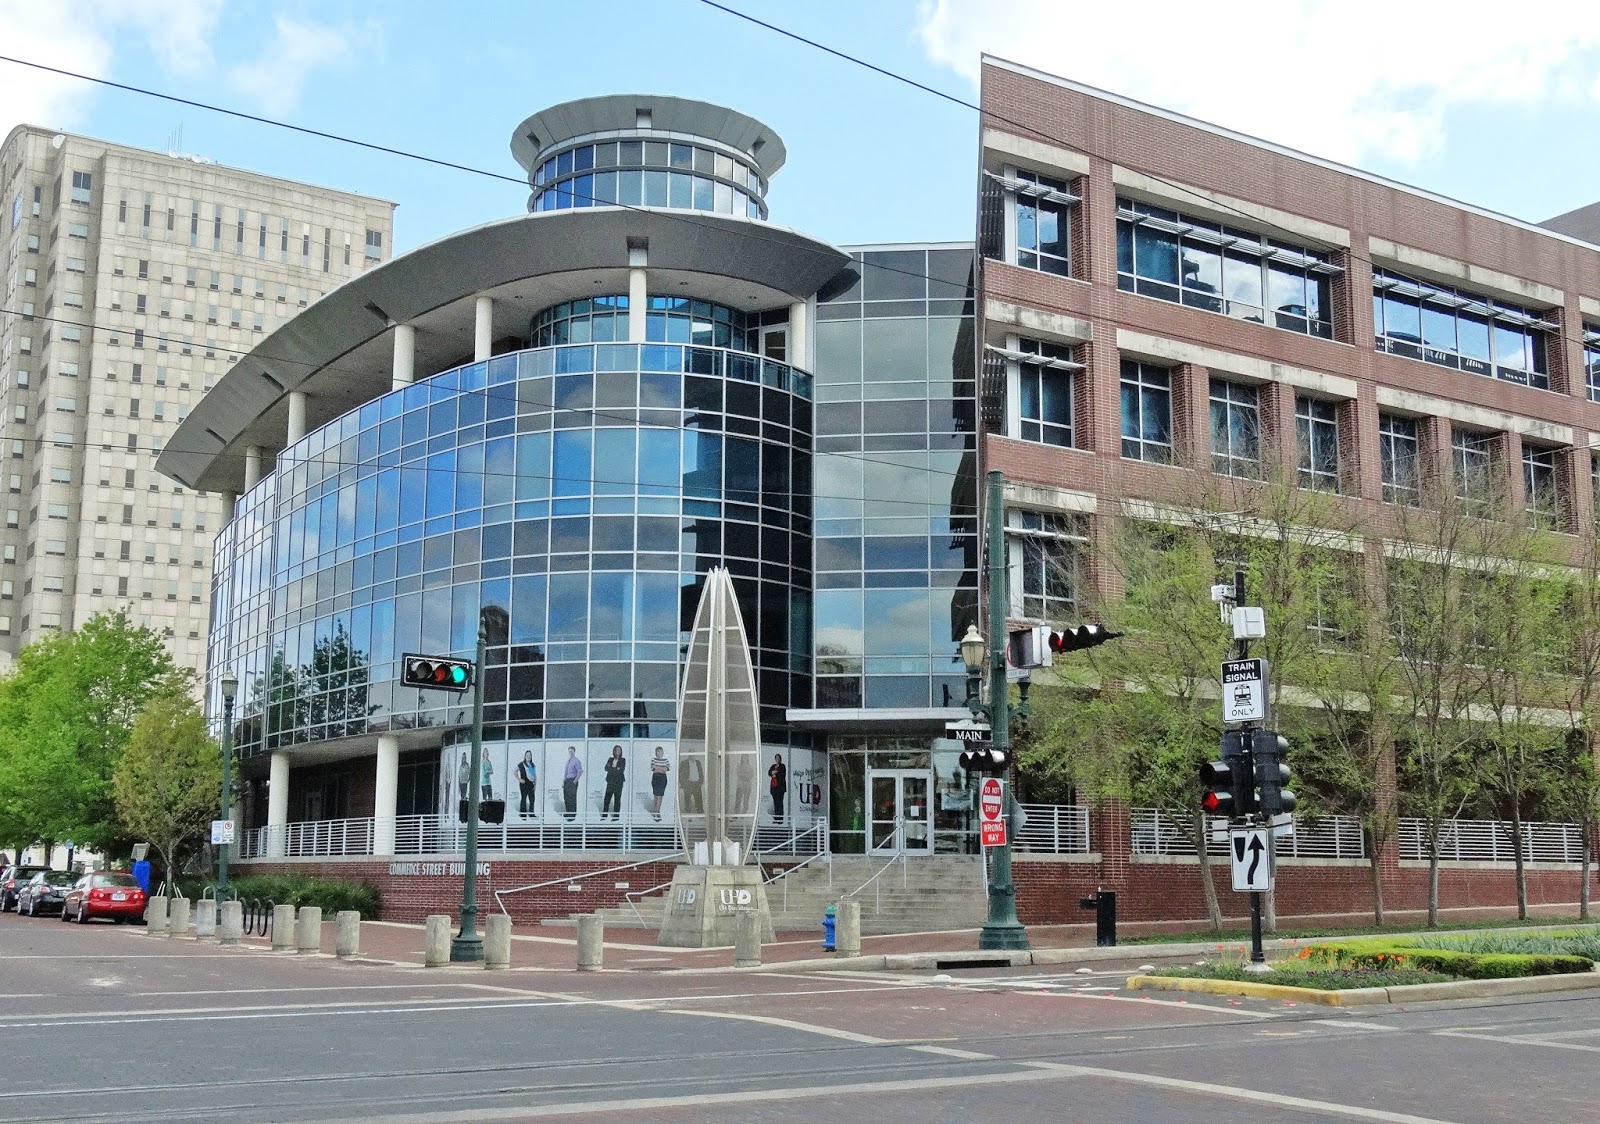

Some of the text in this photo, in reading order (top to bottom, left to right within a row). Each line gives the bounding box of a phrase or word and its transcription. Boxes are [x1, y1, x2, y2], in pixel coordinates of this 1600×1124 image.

[1228, 662, 1255, 671] TRAIN
[1225, 672, 1258, 682] SIGNAL
[1231, 708, 1255, 716] ONLY
[955, 730, 982, 740] MAIN
[984, 786, 1000, 795] DO NOT
[985, 804, 998, 813] ENTER
[983, 823, 1003, 832] WRONG
[987, 833, 1000, 842] WAY
[389, 862, 420, 876] COMMERCE
[421, 862, 447, 876] STREET
[720, 889, 752, 904] UHD
